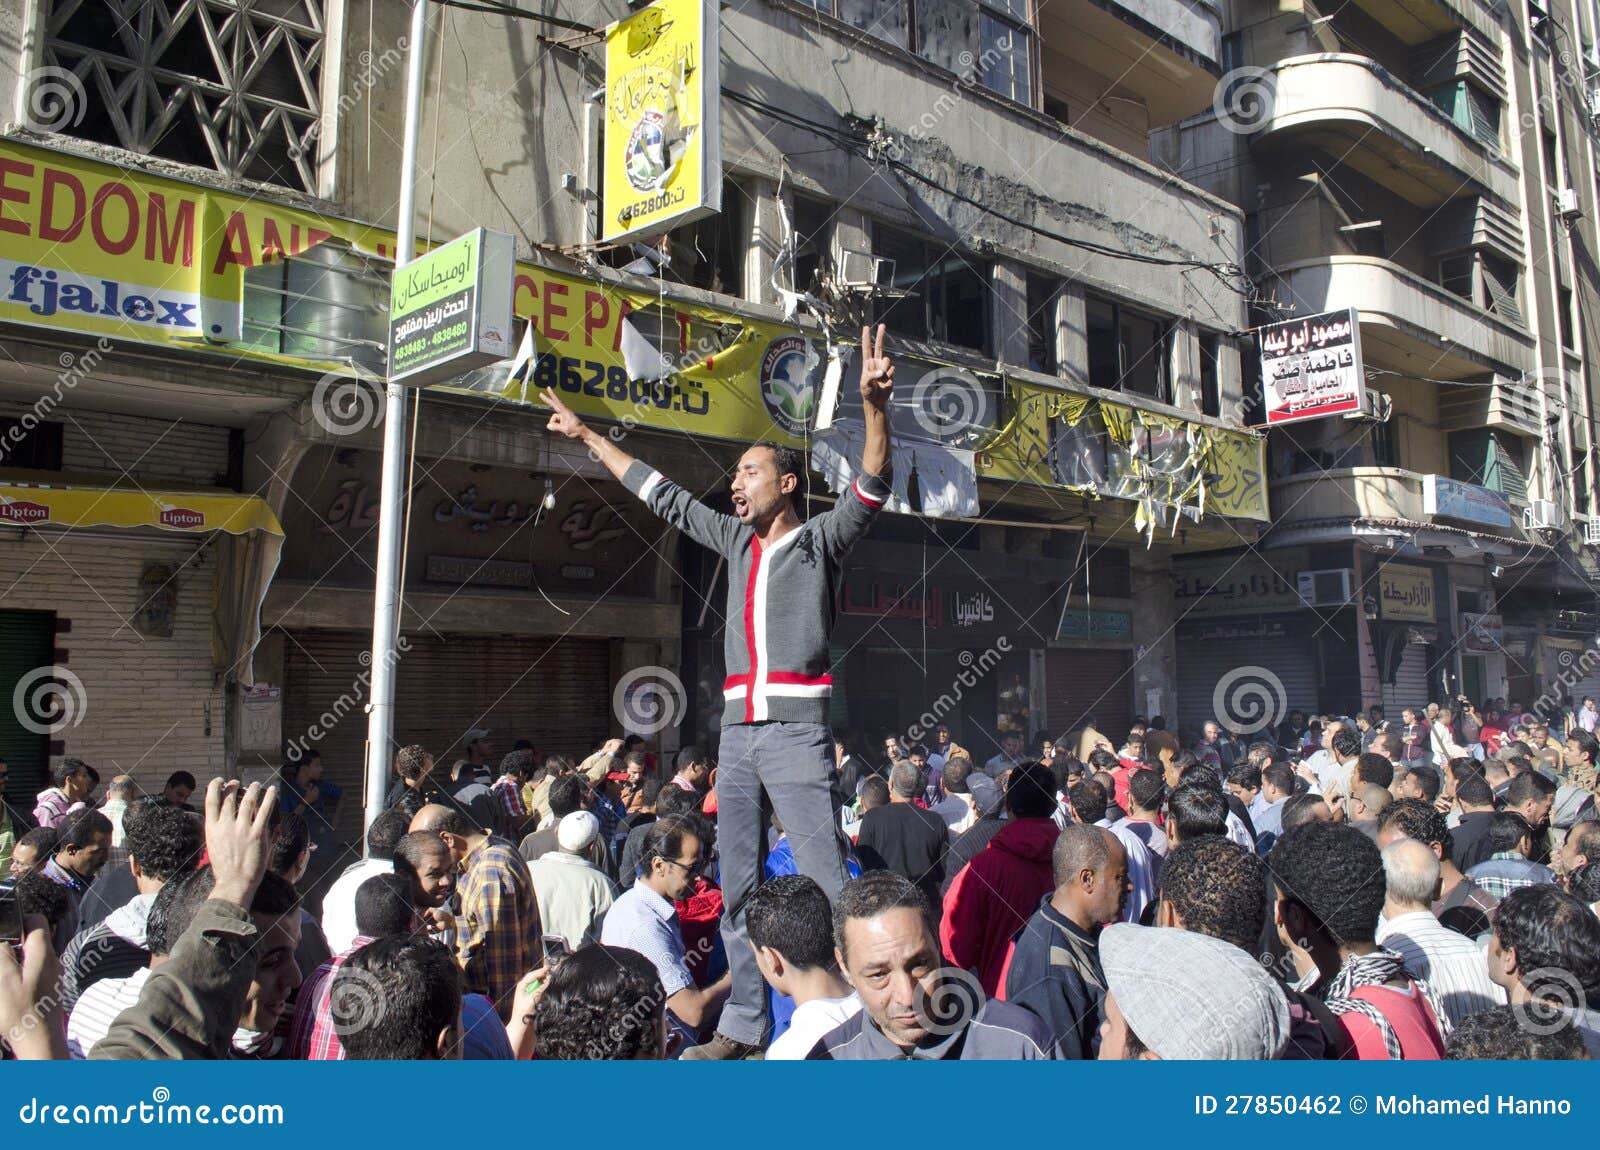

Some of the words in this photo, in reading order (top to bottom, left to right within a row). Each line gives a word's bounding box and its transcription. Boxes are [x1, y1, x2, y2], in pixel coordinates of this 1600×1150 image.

[213, 210, 334, 276] AN
[1290, 321, 1309, 352] أبو
[1312, 321, 1351, 346] محمود
[1304, 349, 1353, 373] فاطمة
[2, 505, 46, 519] Lipton
[163, 512, 202, 525] Lipton
